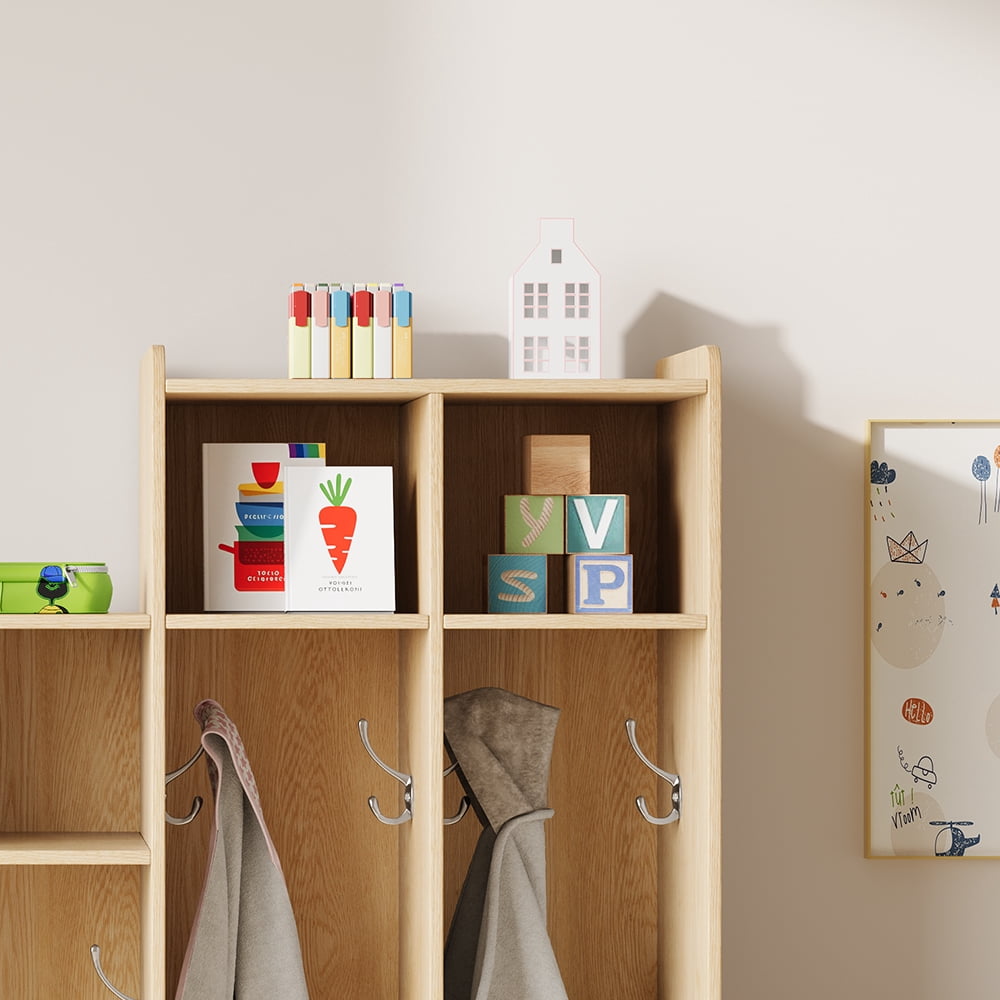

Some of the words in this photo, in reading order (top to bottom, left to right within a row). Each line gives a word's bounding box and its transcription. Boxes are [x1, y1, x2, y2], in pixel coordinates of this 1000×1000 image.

[520, 498, 554, 547] y
[573, 499, 619, 549] V
[583, 564, 625, 605] P
